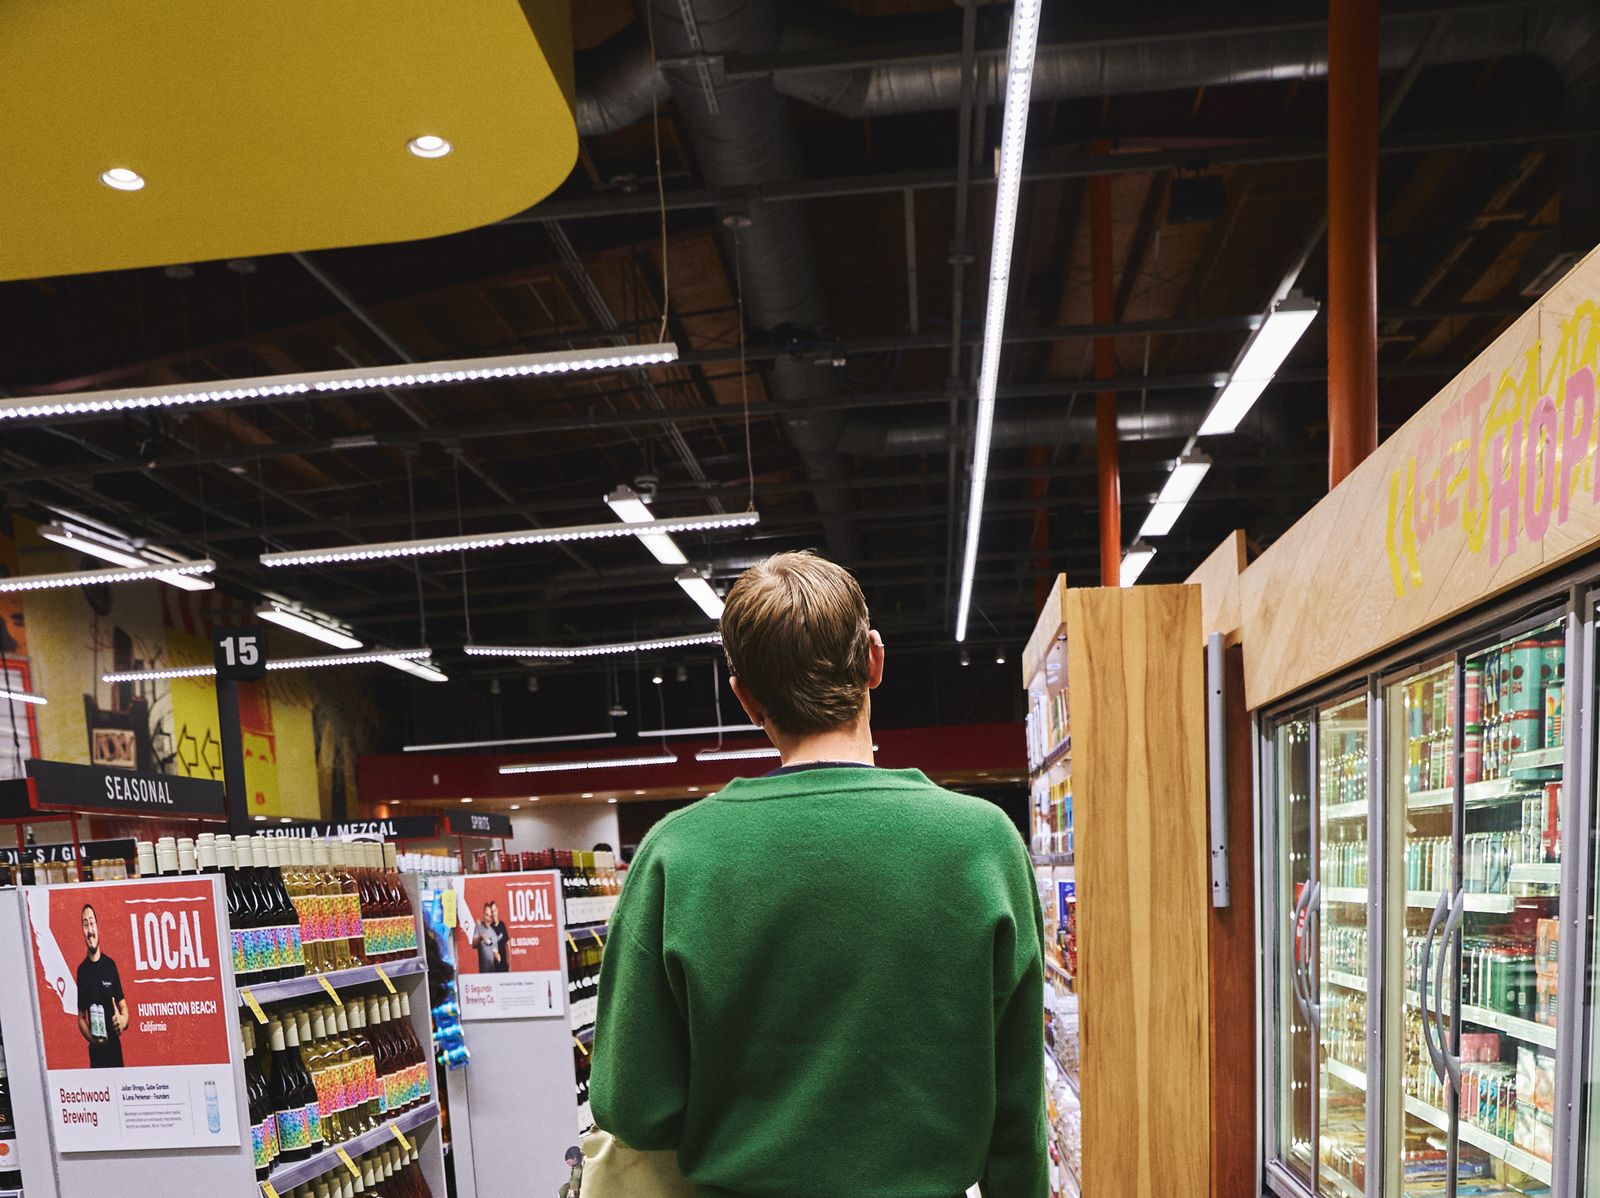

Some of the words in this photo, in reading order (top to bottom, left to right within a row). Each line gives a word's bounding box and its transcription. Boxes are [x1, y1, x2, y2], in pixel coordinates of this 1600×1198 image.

[1413, 373, 1491, 544] GET
[1490, 367, 1600, 568] HOP
[220, 636, 259, 666] 15
[105, 775, 173, 804] SEASONAL
[337, 821, 397, 837] MEZCAL
[508, 889, 552, 921] LOCAL
[130, 910, 210, 970] LOCAL
[138, 1001, 189, 1016] HUNTINGTON
[191, 1000, 217, 1015] BEACH
[140, 1021, 167, 1033] California
[60, 1086, 110, 1103] Beachwood
[62, 1107, 98, 1127] Brewing
